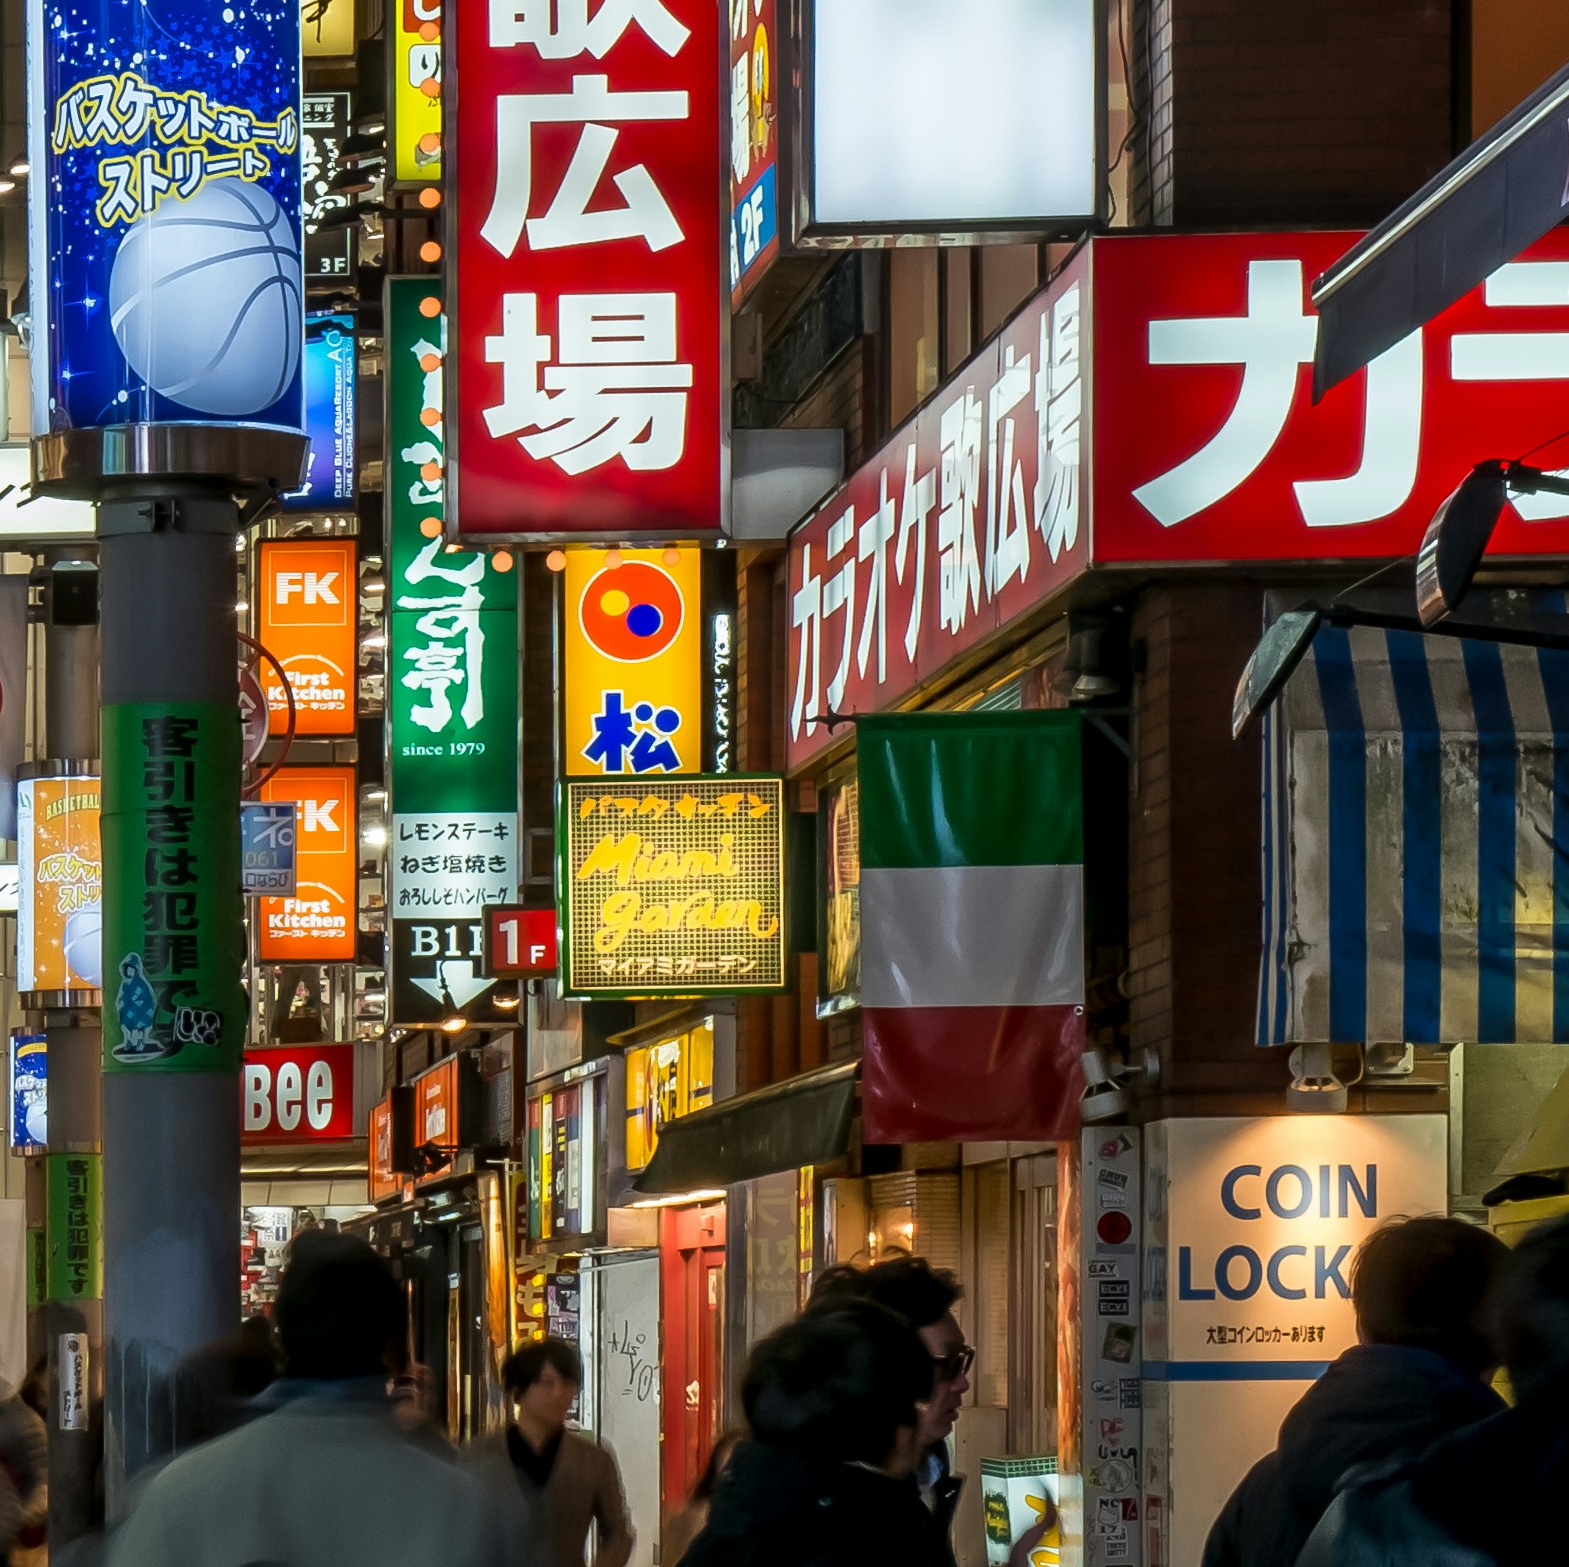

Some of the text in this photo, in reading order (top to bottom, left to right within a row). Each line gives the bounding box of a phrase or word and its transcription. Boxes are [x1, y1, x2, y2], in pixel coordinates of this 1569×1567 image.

[55, 75, 297, 154] バスケットボール
[99, 151, 268, 225] ストリート
[320, 257, 347, 273] 3F
[791, 278, 1083, 744] カラオケ歌広場
[275, 571, 340, 605] FK
[284, 671, 330, 687] First
[268, 685, 345, 701] Kitchen
[401, 742, 486, 757] since 1979
[45, 794, 100, 821] BASKETBAL
[399, 821, 510, 842] レモンステーキ
[400, 854, 508, 875] ねぎ塩焼き
[142, 715, 200, 1050] 客引きは犯罪で
[284, 898, 330, 914] First
[268, 913, 346, 928] Kitchen
[498, 918, 546, 964] 1F
[1220, 1162, 1378, 1221] COIN
[1177, 1243, 1354, 1302] LOCK
[1205, 1324, 1326, 1346] 大型コインロッカーあります
